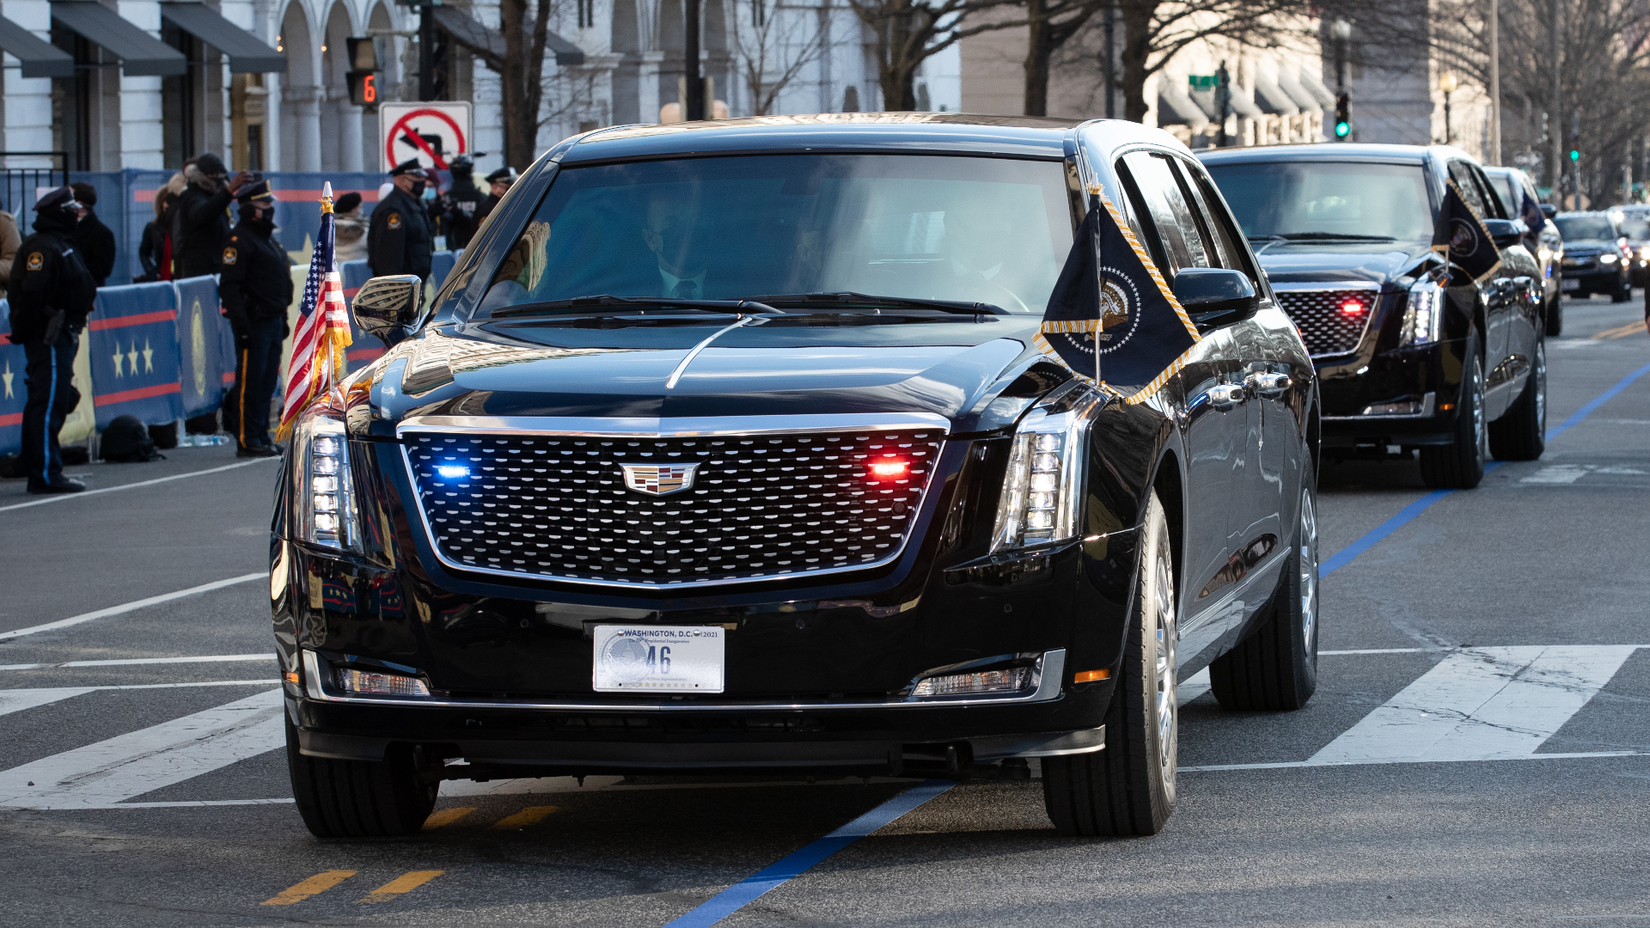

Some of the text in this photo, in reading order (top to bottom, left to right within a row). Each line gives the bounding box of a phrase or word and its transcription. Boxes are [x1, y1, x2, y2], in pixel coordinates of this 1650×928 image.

[364, 75, 376, 102] 6
[624, 630, 677, 638] WASHINGTON,
[646, 645, 671, 675] 46
